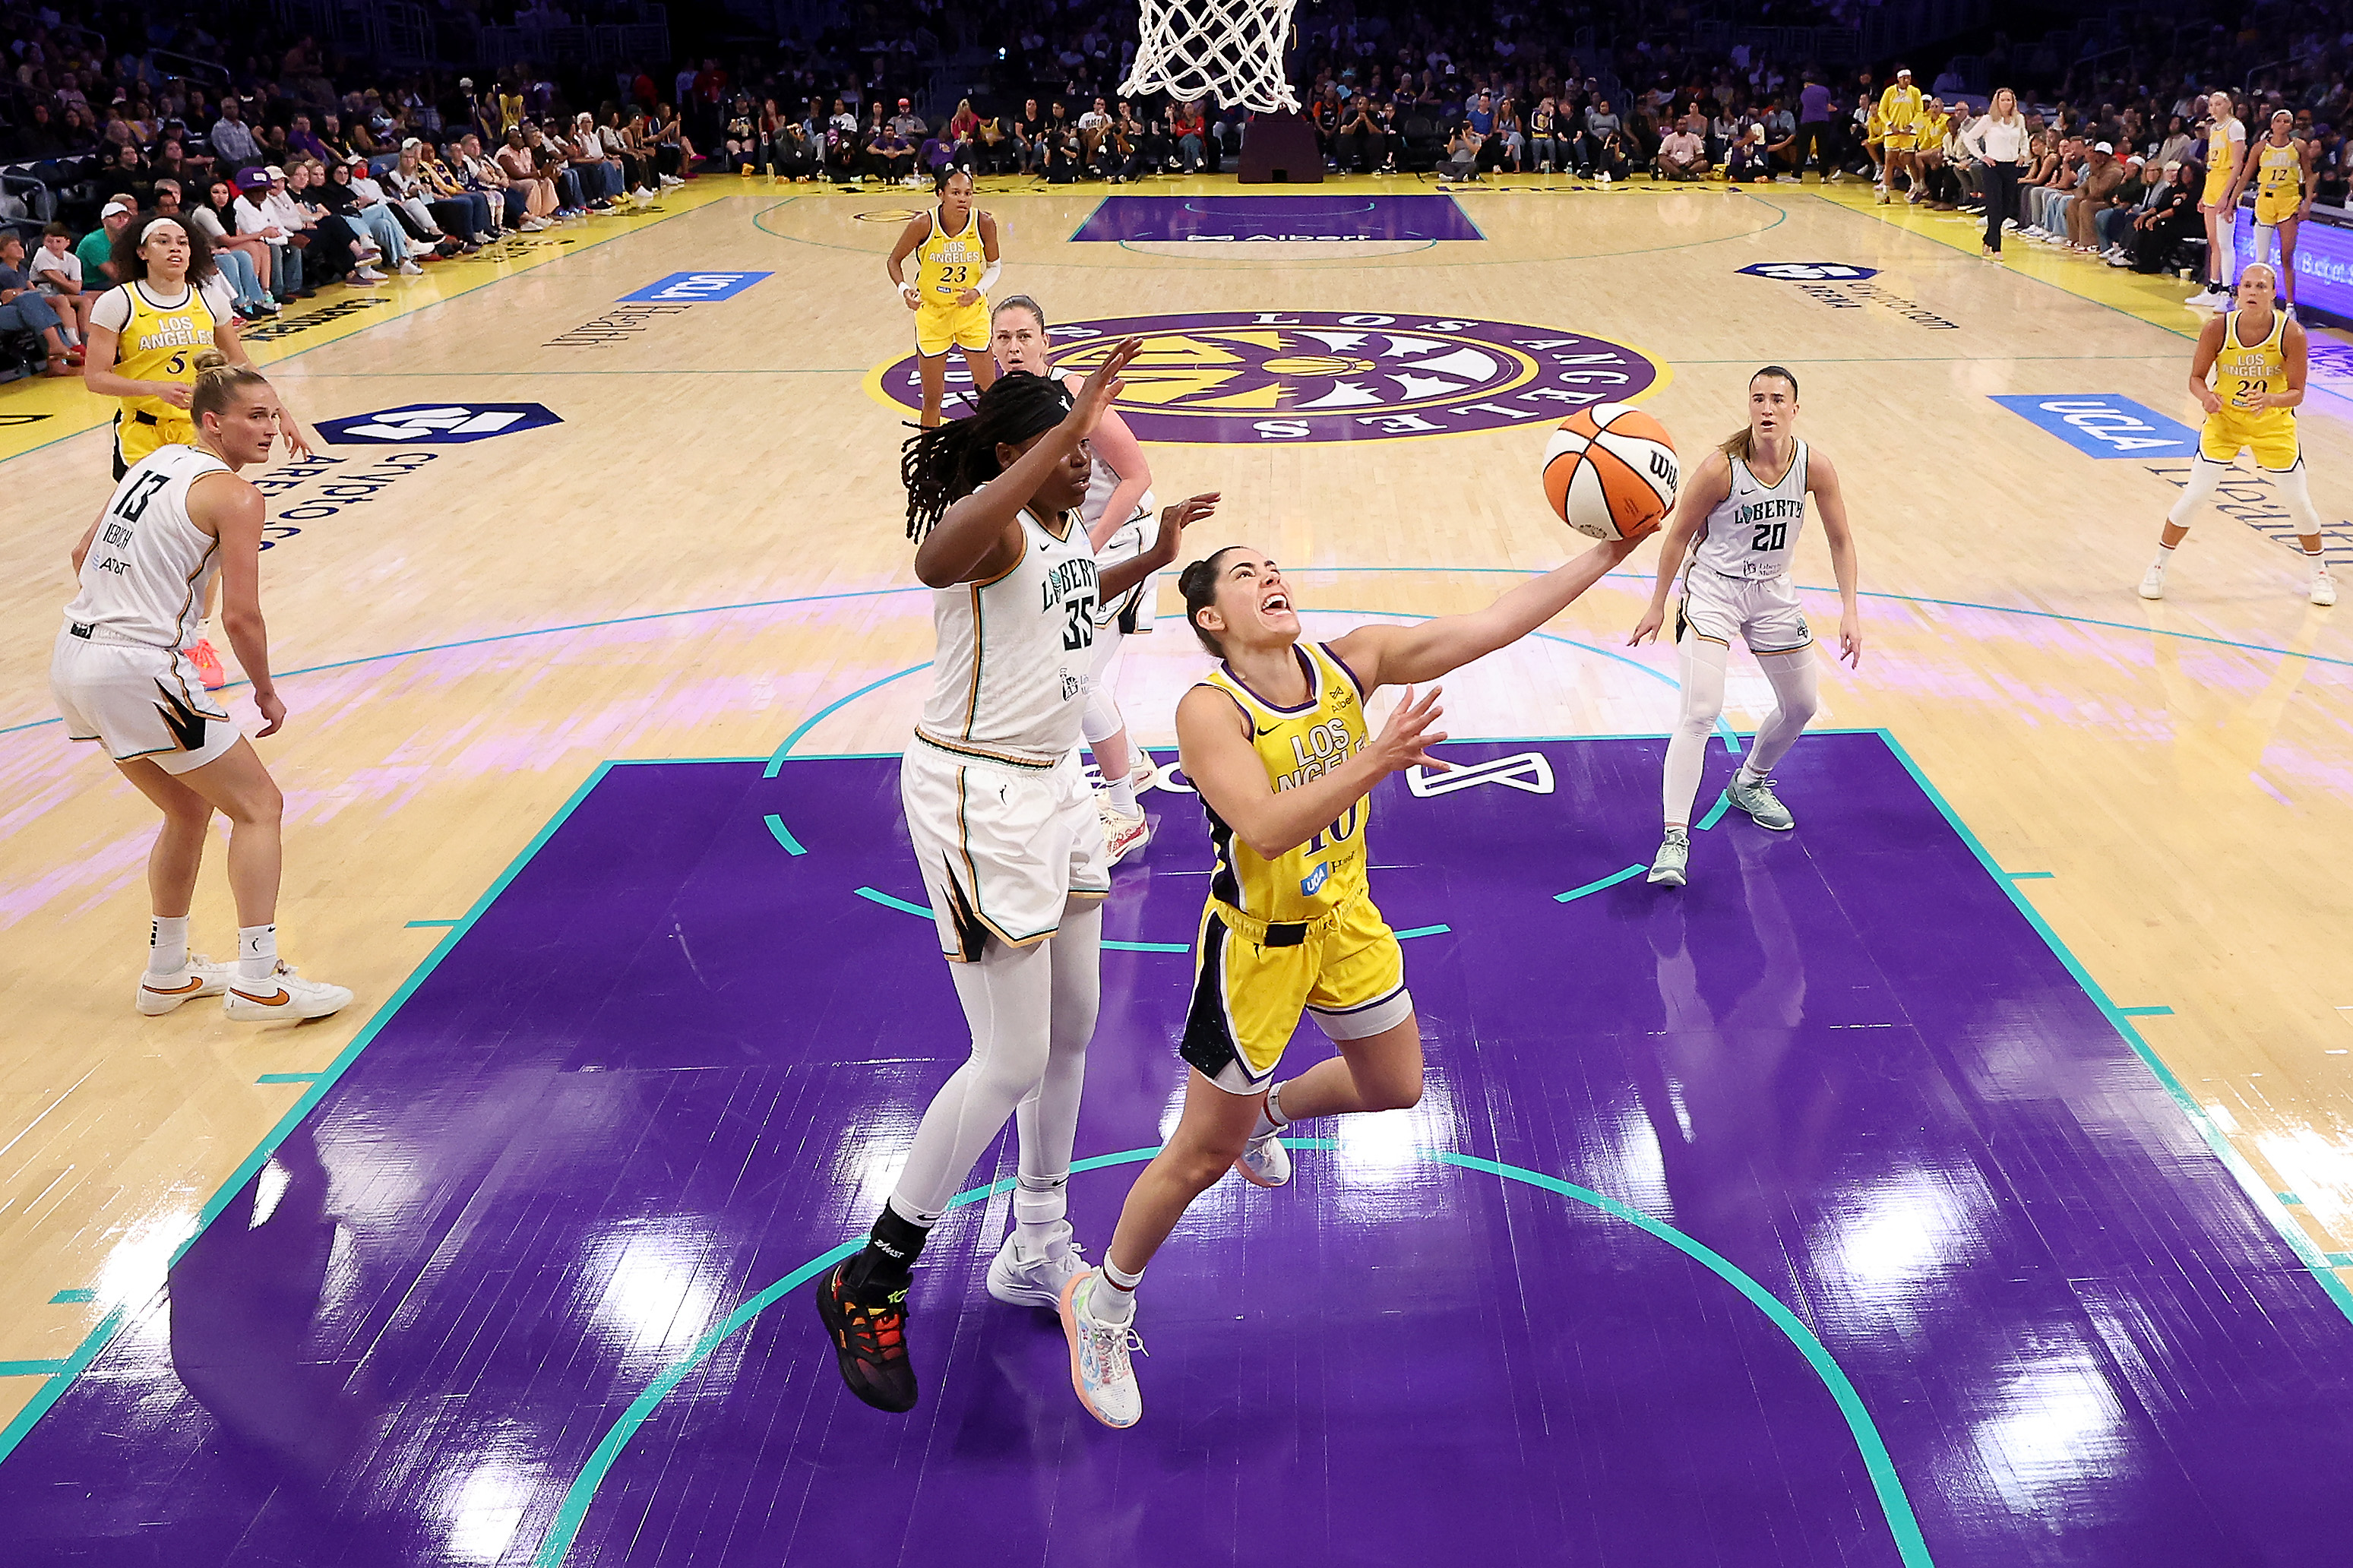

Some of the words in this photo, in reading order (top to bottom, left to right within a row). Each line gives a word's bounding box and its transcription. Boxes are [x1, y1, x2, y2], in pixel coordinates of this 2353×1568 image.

[2271, 169, 2288, 181] 12
[929, 251, 980, 263] ANGELES
[944, 242, 966, 253] LOS
[650, 274, 744, 299] UCLA
[940, 266, 967, 283] 23
[158, 316, 194, 332] LOS
[1251, 311, 1481, 333] LOS
[166, 350, 188, 375] 5
[2222, 365, 2282, 377] ANGELES
[2238, 354, 2264, 366] LOS
[2235, 380, 2268, 397] 20
[2039, 400, 2185, 452] UCLA
[251, 455, 349, 497] ARE
[113, 469, 171, 523] 13
[103, 523, 133, 549] IEBICH
[1752, 522, 1788, 552] 20
[1042, 558, 1099, 614] LIBERT
[1063, 596, 1095, 651] 35
[1289, 717, 1351, 768] LOS
